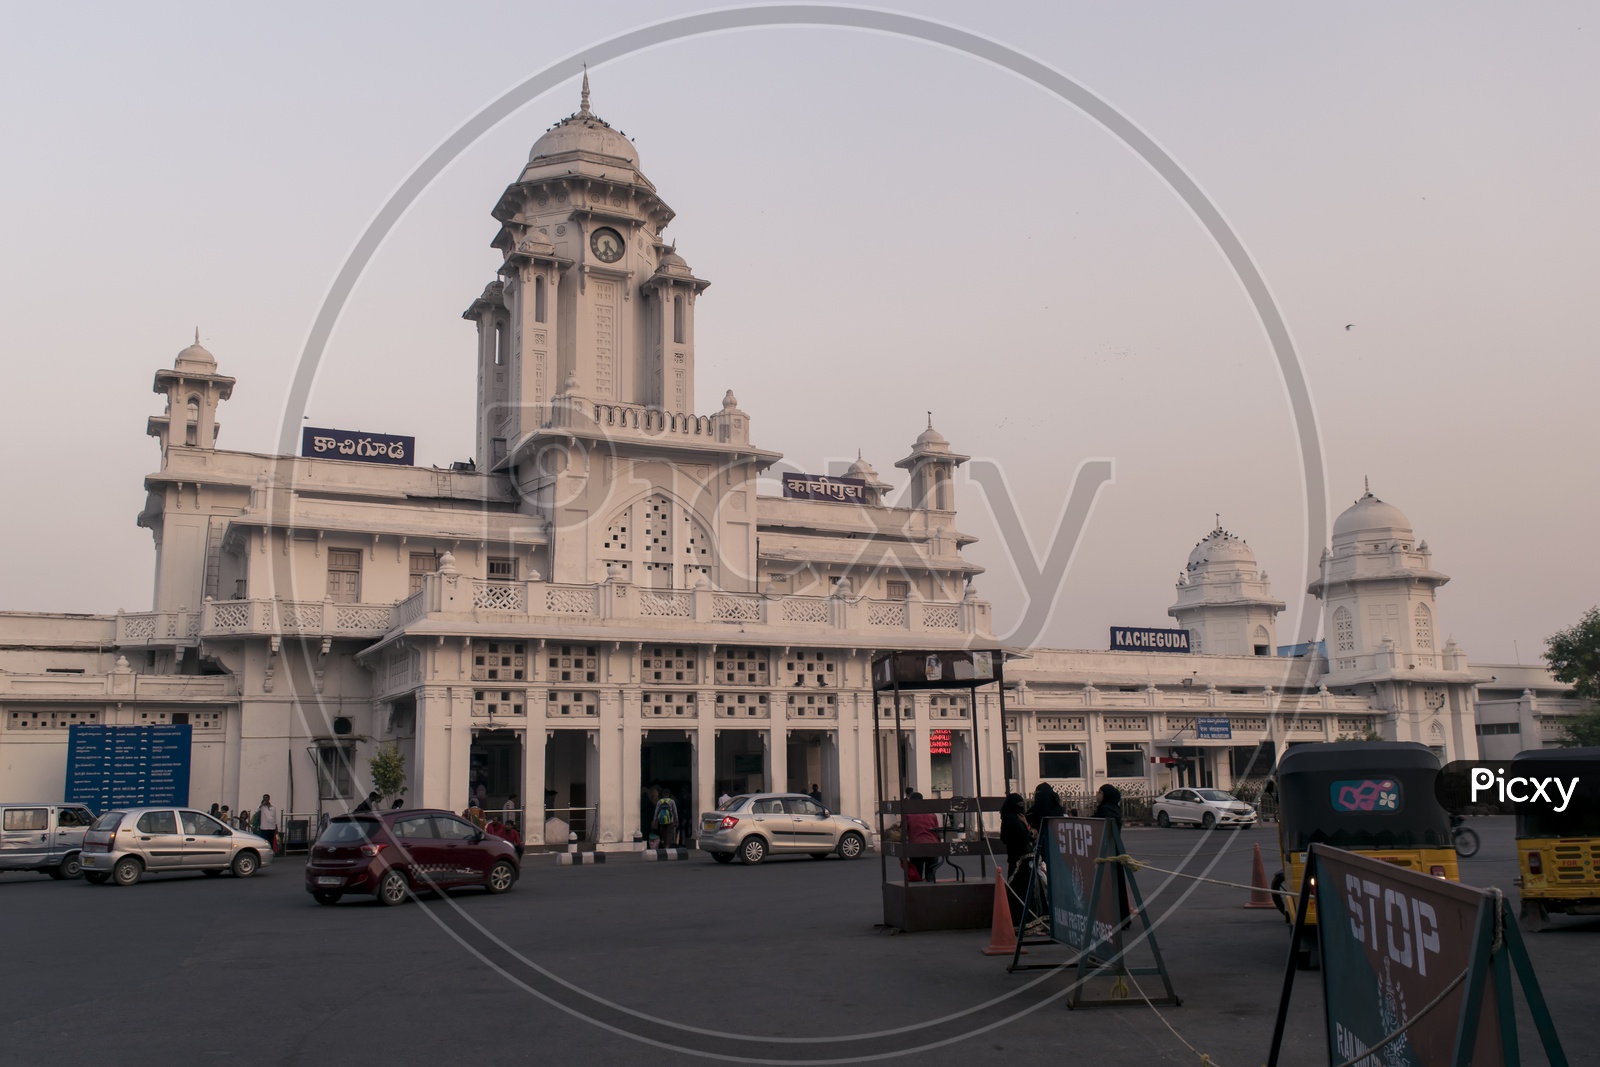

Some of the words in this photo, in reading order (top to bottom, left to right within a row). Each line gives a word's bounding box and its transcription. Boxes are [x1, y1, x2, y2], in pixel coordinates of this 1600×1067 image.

[313, 436, 405, 459] కాచిగూడ
[787, 477, 864, 501] काचीगुडा
[1115, 630, 1188, 649] KACHEGUDA
[1057, 822, 1093, 858] STOP
[1345, 873, 1441, 977] STOP
